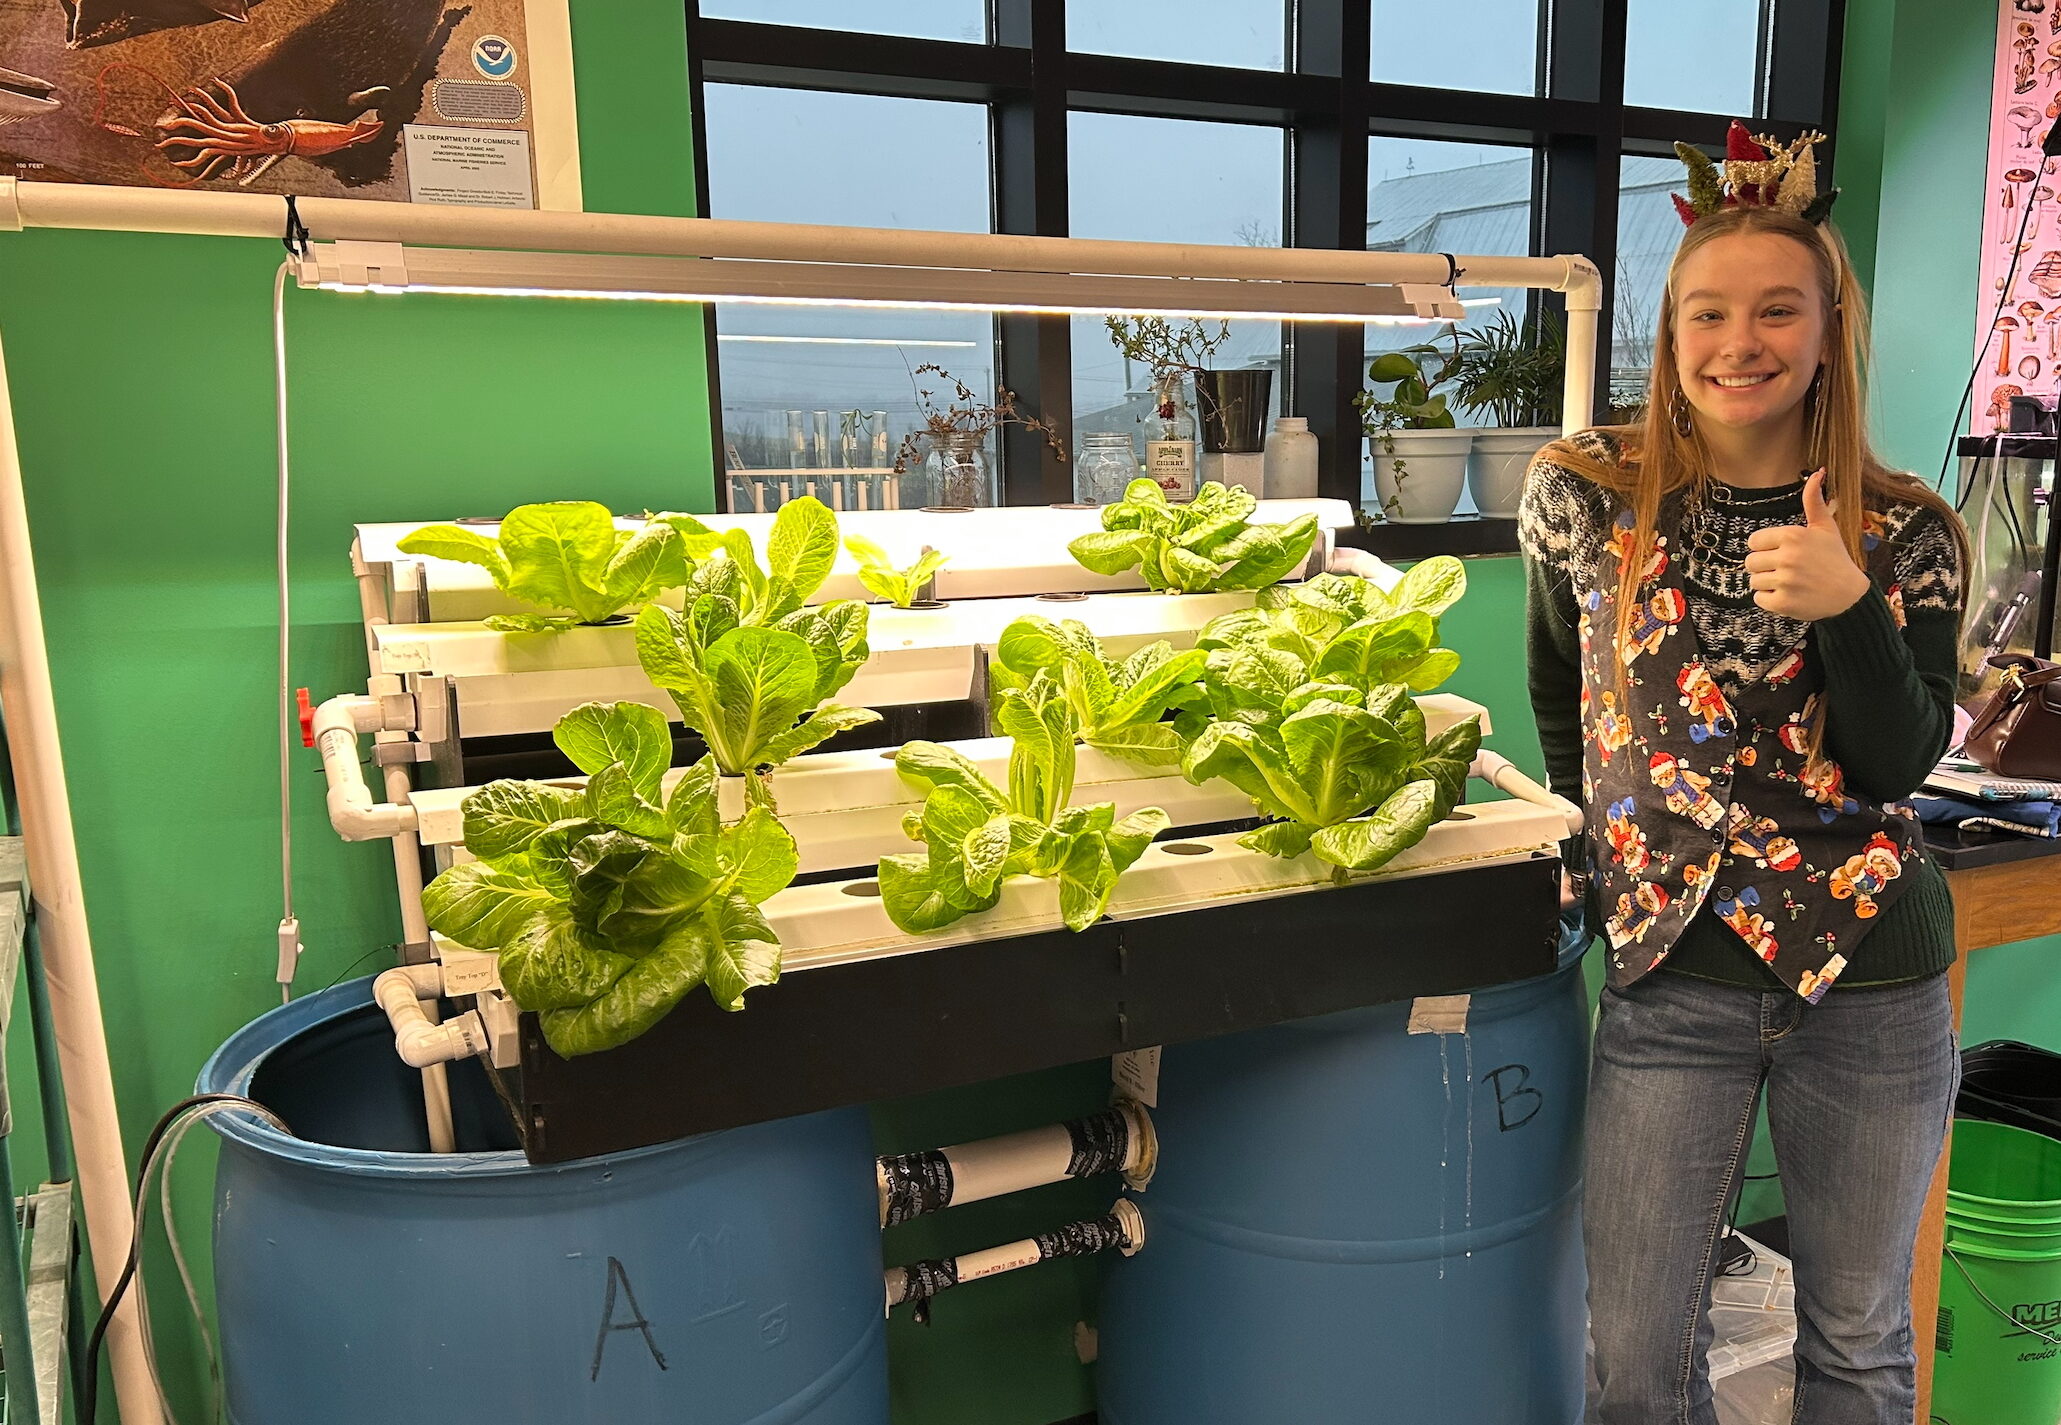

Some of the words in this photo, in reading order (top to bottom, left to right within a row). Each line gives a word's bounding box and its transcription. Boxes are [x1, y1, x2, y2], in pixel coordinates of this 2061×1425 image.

[427, 134, 471, 143] DEPARTMENT
[482, 138, 520, 146] COMMERCE
[1481, 1063, 1543, 1132] B
[592, 1256, 668, 1382] A
[2011, 1300, 2061, 1327] ME
